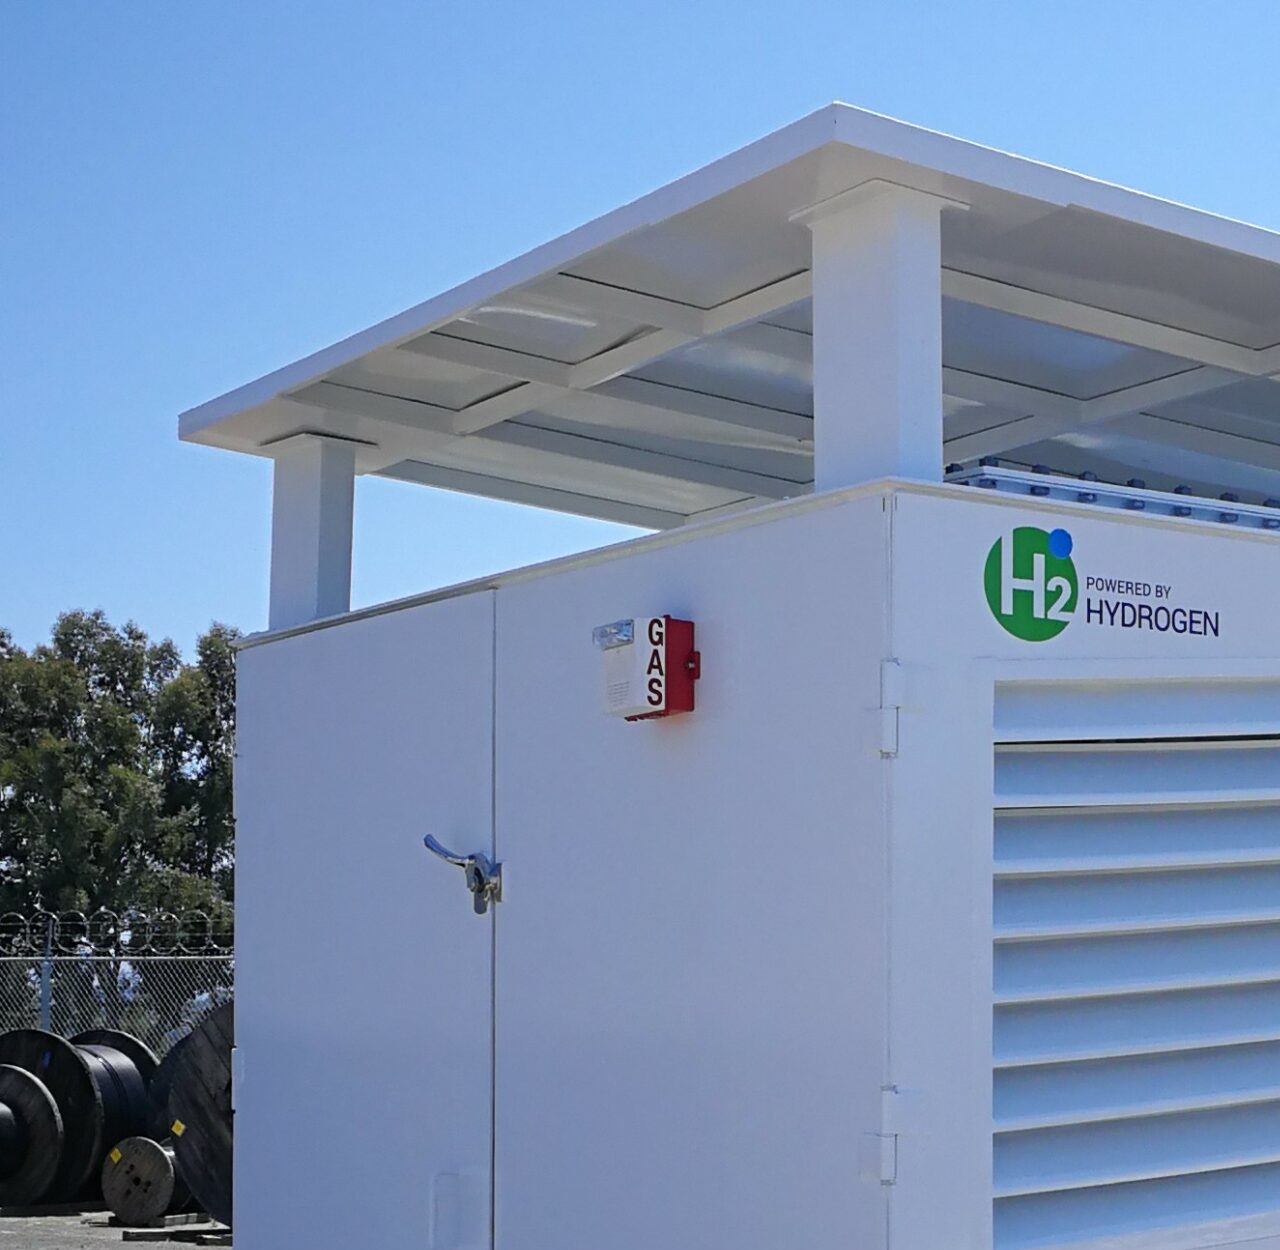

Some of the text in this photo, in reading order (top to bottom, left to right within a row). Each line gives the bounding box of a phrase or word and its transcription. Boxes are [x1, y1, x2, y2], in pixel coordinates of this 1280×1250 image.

[1001, 529, 1075, 622] H2
[1086, 576, 1172, 599] POWERED BY
[1086, 598, 1220, 637] HYDROGEN
[646, 618, 664, 706] GAS
